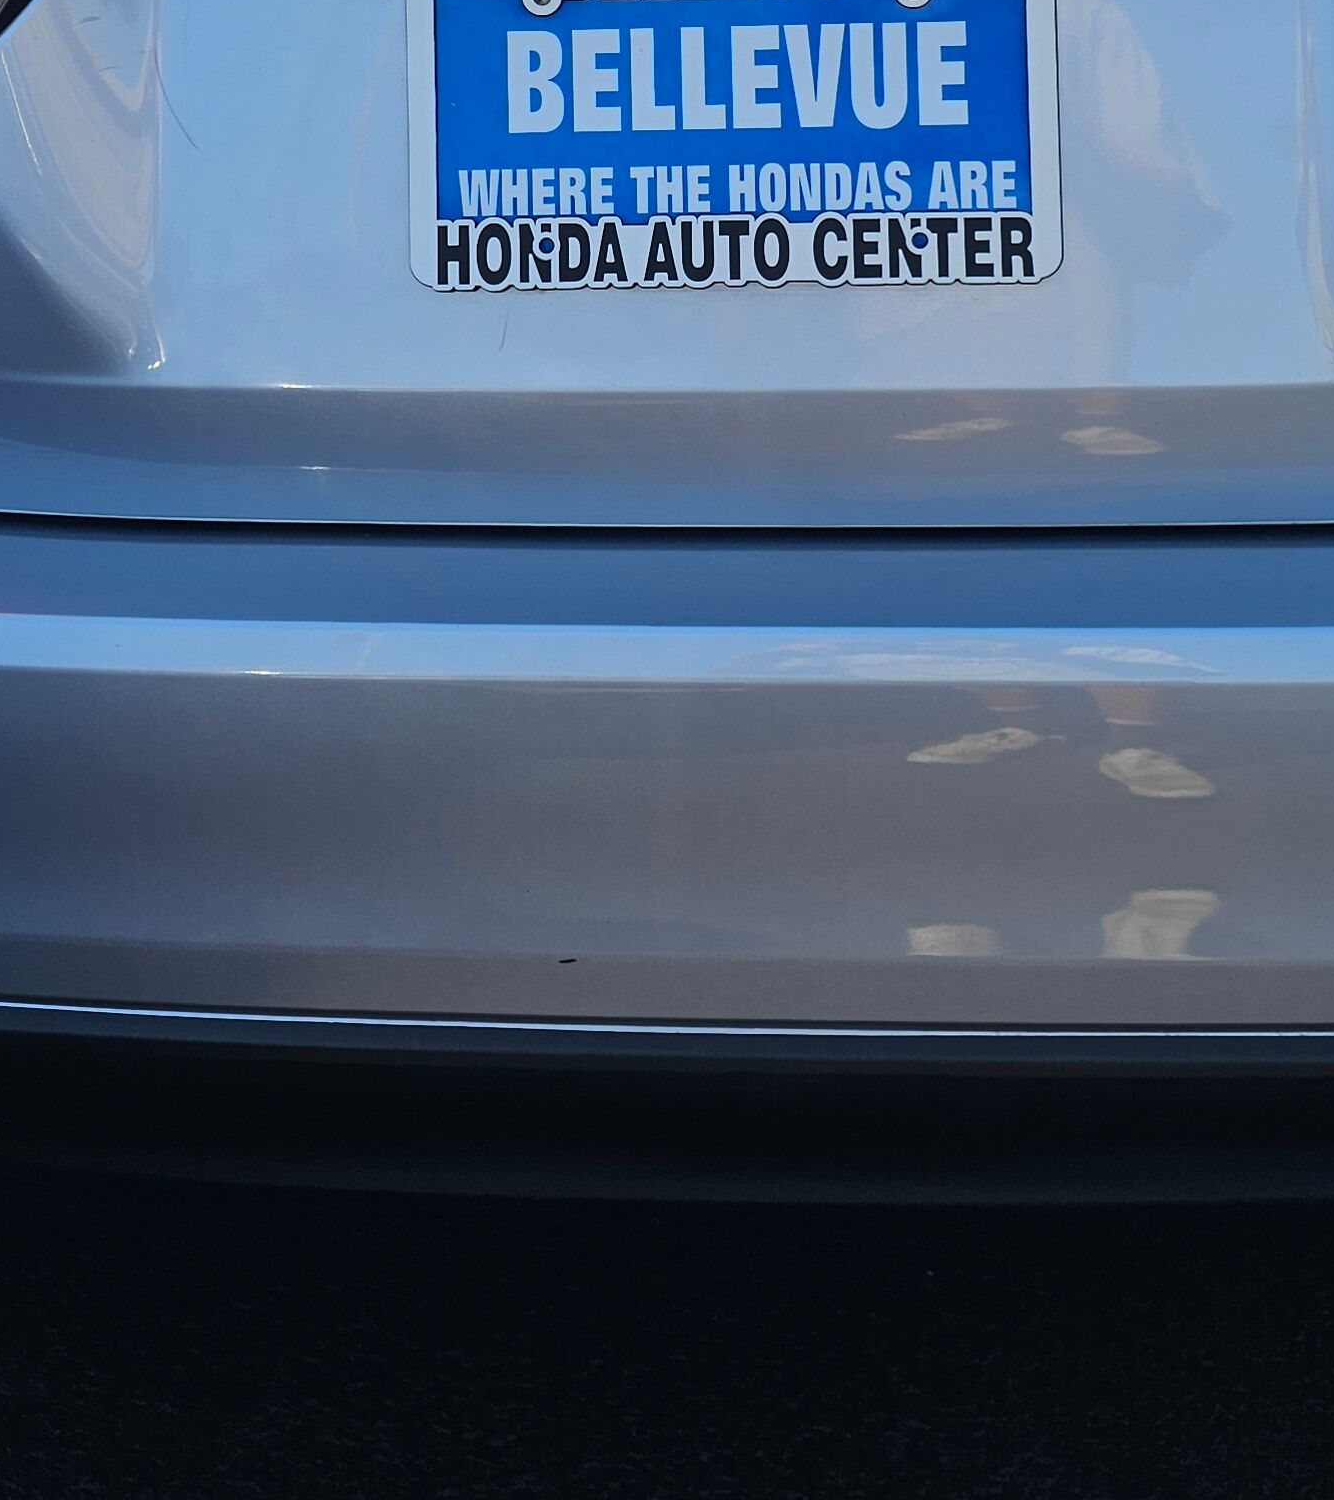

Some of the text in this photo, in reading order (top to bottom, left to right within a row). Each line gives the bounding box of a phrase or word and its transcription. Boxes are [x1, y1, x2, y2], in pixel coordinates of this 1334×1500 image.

[506, 20, 969, 135] BELLEVUE
[458, 159, 1018, 217] WHERE THE HONDAS ARE
[436, 215, 1036, 286] HONDA AUTO CENTER
